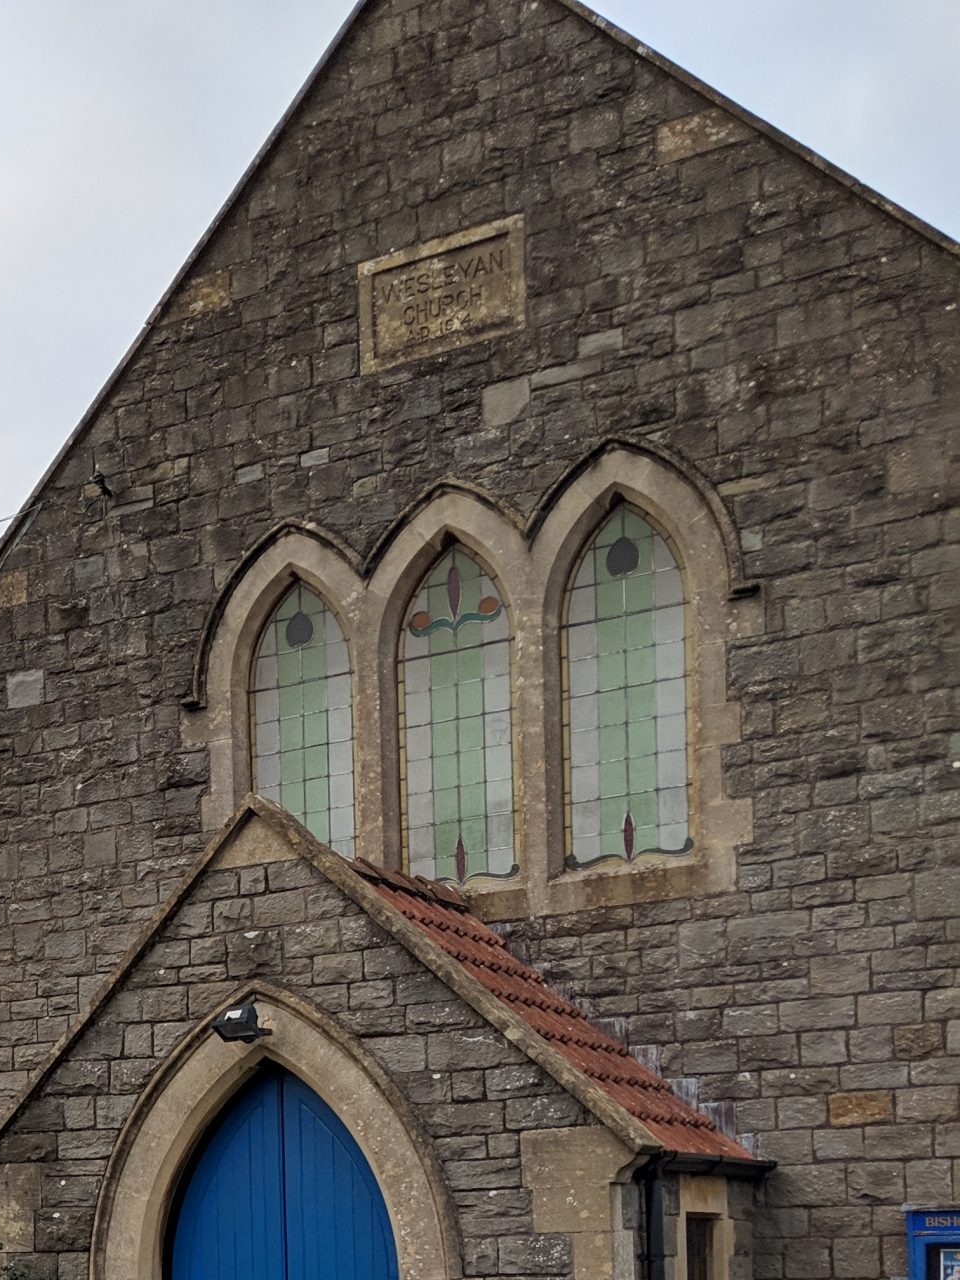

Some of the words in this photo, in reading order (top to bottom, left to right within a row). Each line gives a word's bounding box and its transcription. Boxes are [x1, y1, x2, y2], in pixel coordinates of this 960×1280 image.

[380, 249, 503, 305] WESLEYAN
[403, 284, 482, 326] CHURCH
[925, 1216, 960, 1227] BISH
